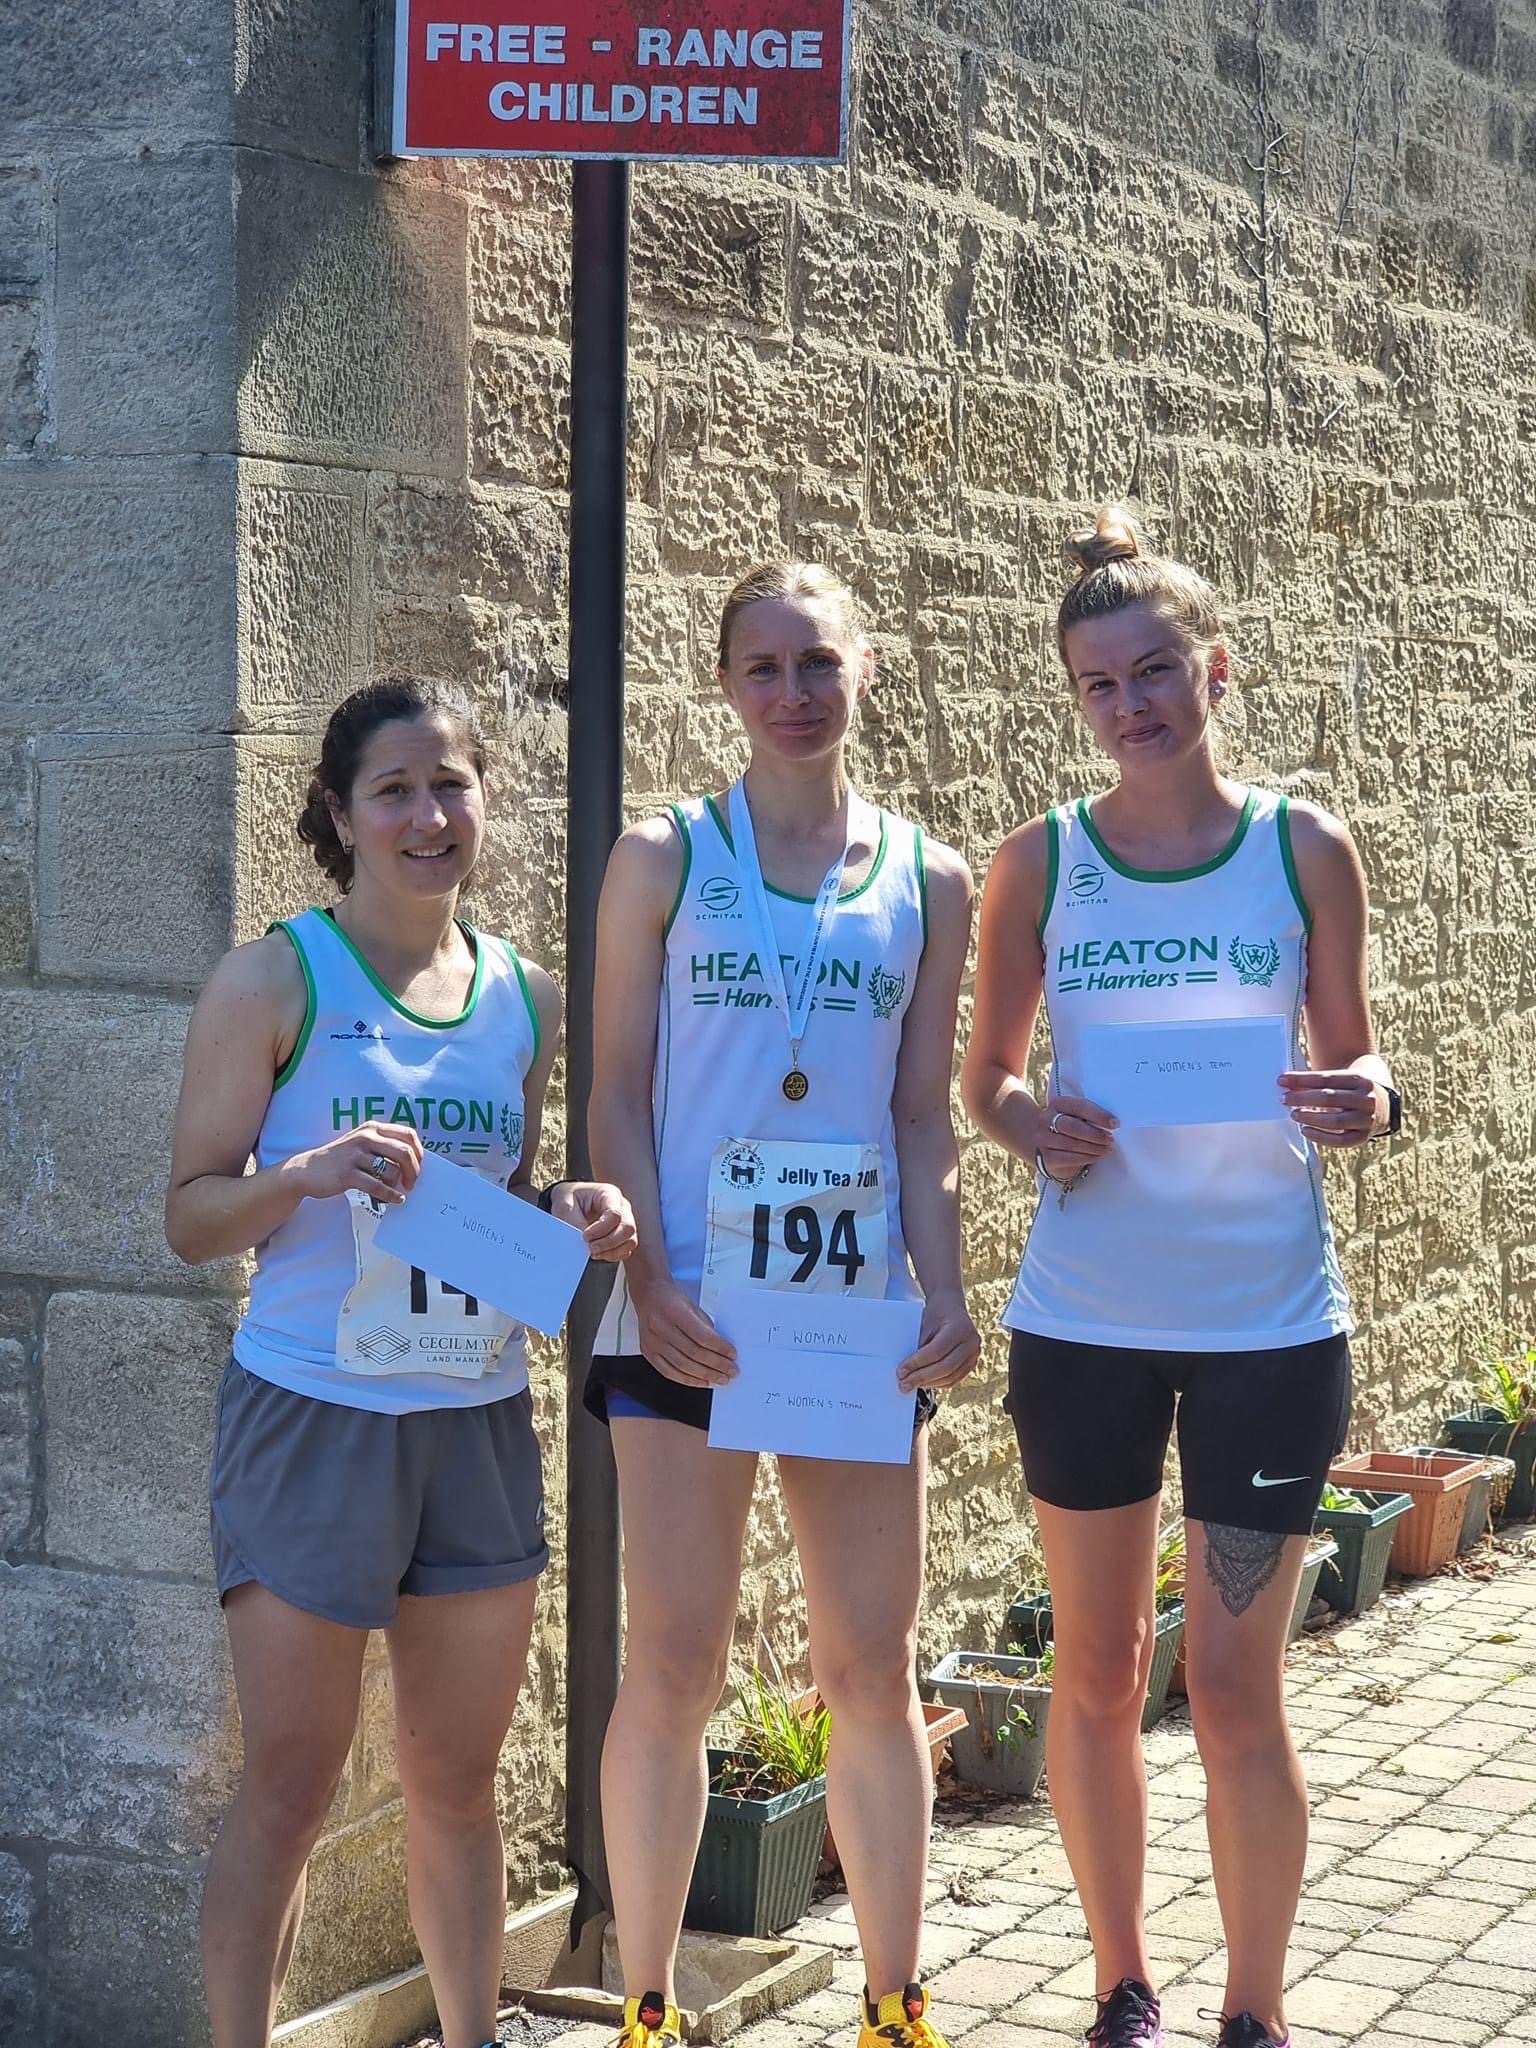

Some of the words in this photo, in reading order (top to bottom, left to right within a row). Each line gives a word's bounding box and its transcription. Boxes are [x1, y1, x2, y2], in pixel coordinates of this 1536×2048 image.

[426, 23, 566, 65] FREE
[591, 40, 611, 52] -
[637, 27, 823, 69] RANGE
[488, 81, 758, 126] CHILDREN
[1066, 897, 1109, 907] SCIMITAR
[696, 913, 743, 921] SCIMITAR
[1058, 935, 1218, 972] HEATON
[1086, 970, 1180, 991] Harriers
[332, 1096, 494, 1133] HEATON
[777, 1167, 818, 1187] Jelly
[823, 1170, 851, 1187] Tea
[857, 1169, 879, 1188] 10M
[749, 1203, 866, 1286] 194
[419, 1336, 462, 1350] CECIL
[793, 1330, 848, 1345] WOMAN
[427, 1355, 450, 1363] LAND
